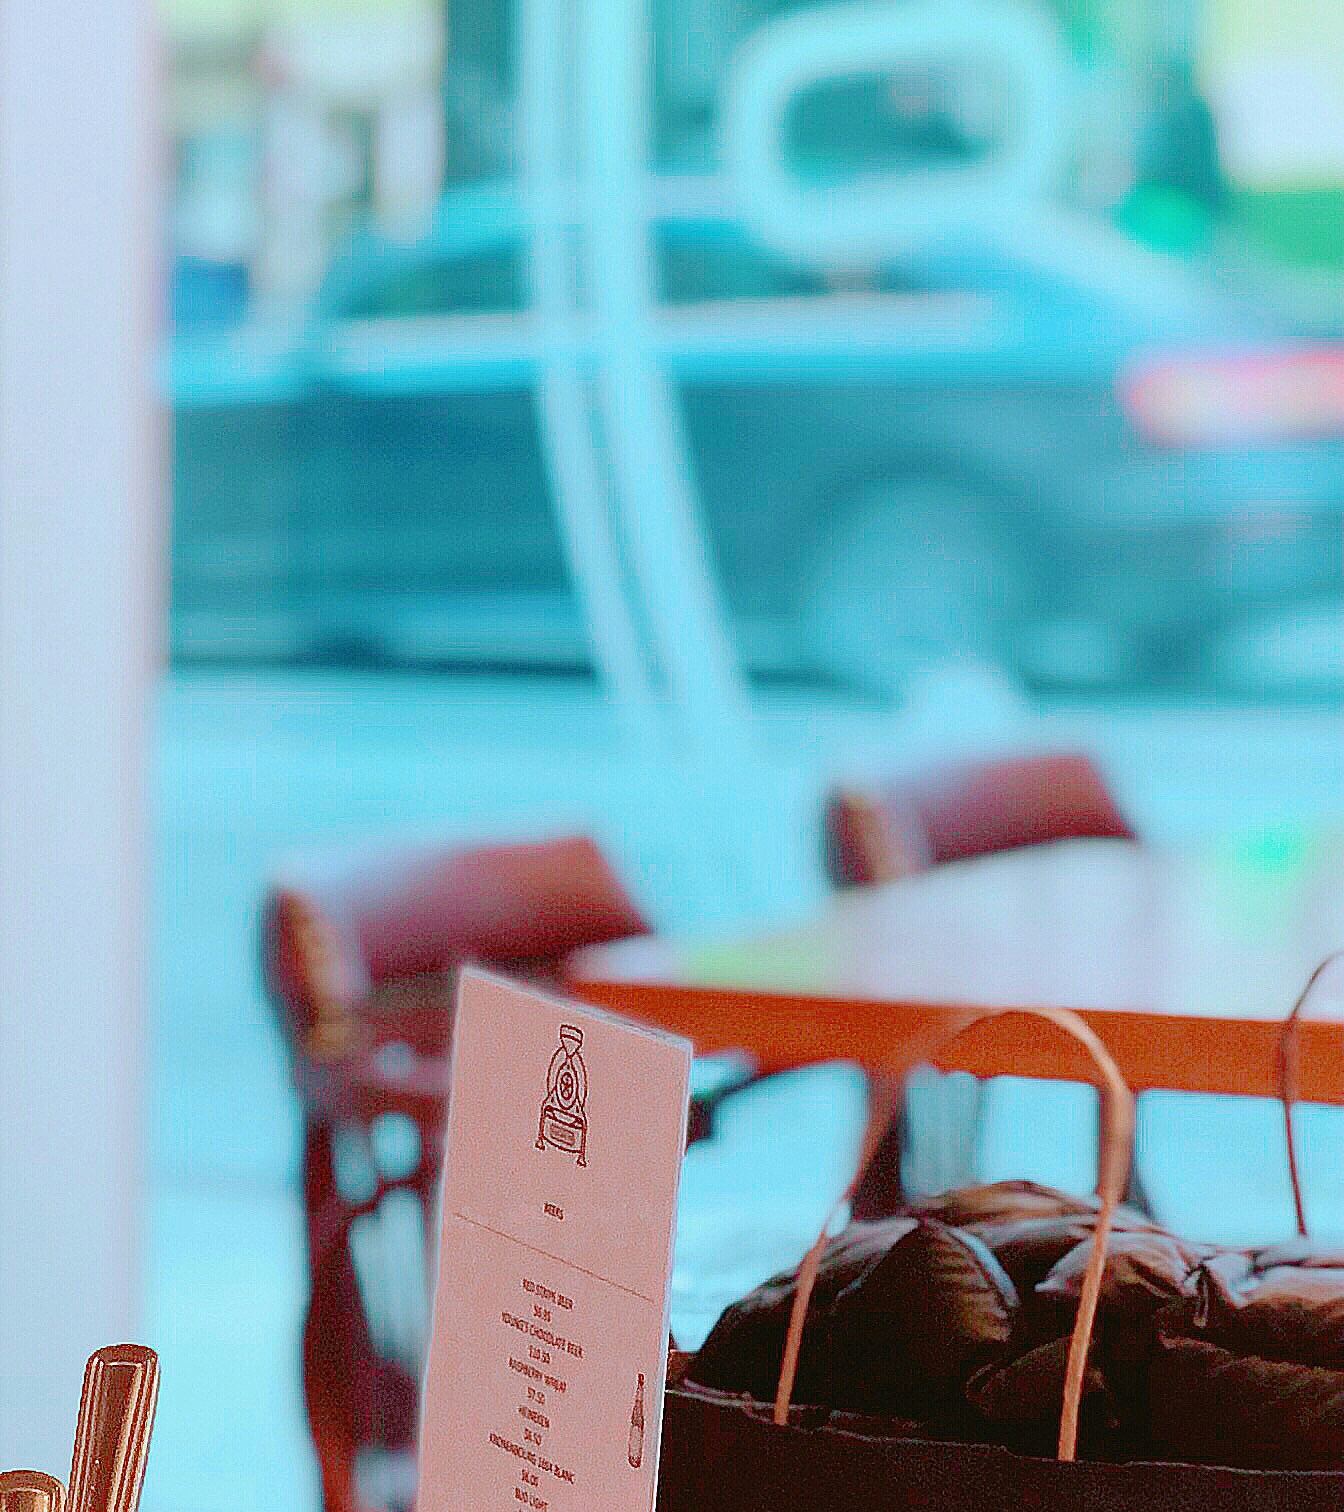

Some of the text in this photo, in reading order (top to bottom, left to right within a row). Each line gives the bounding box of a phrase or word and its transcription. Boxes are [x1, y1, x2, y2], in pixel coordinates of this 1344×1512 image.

[544, 1201, 564, 1220] BEERS
[522, 1278, 535, 1293] RED
[557, 1294, 573, 1310] BEER
[529, 1324, 566, 1350] CHOCOLATE
[567, 1341, 583, 1358] BEER
[509, 1356, 542, 1382] RASPBERRY
[527, 1387, 545, 1405] $7.50
[518, 1404, 550, 1428] HEINEKEN
[515, 1487, 548, 1512] BUD LIGHT
